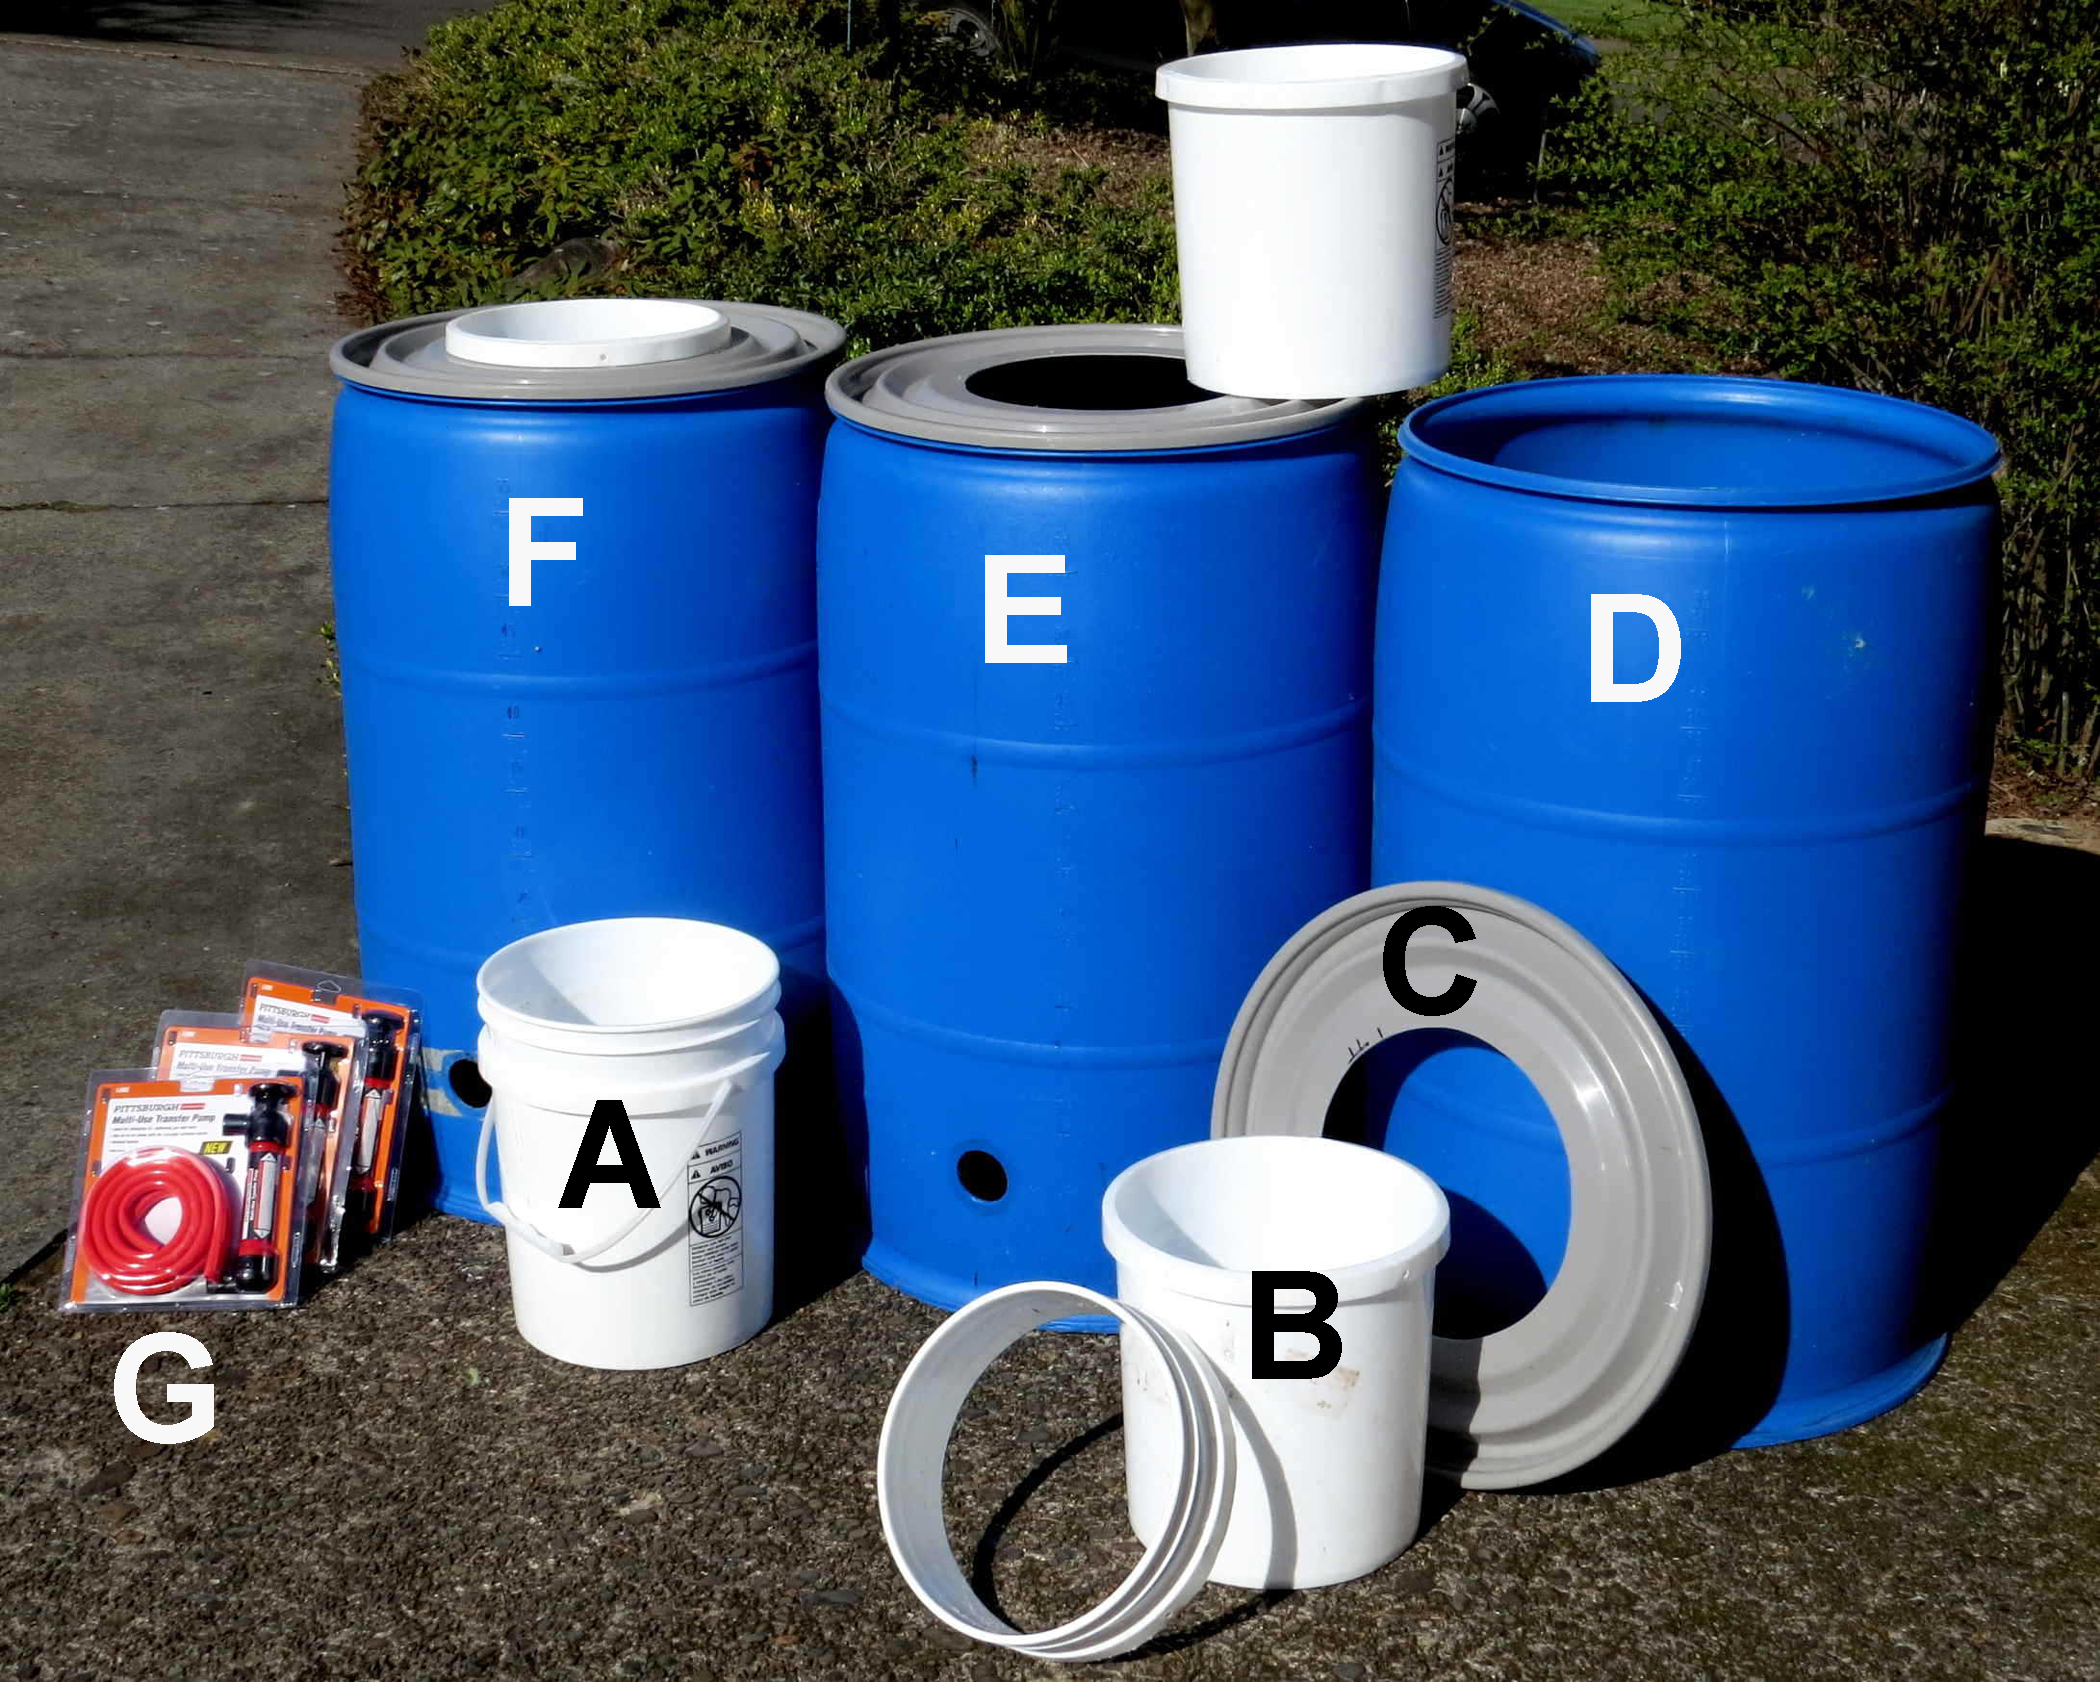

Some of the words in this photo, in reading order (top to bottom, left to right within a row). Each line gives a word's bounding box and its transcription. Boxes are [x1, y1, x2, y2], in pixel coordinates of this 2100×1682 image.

[114, 1103, 180, 1113] PITTSBURGH
[112, 1115, 153, 1124] Multi-Use
[156, 1114, 190, 1123] Transfer
[192, 1113, 216, 1123] Pump
[204, 1142, 228, 1154] NEW
